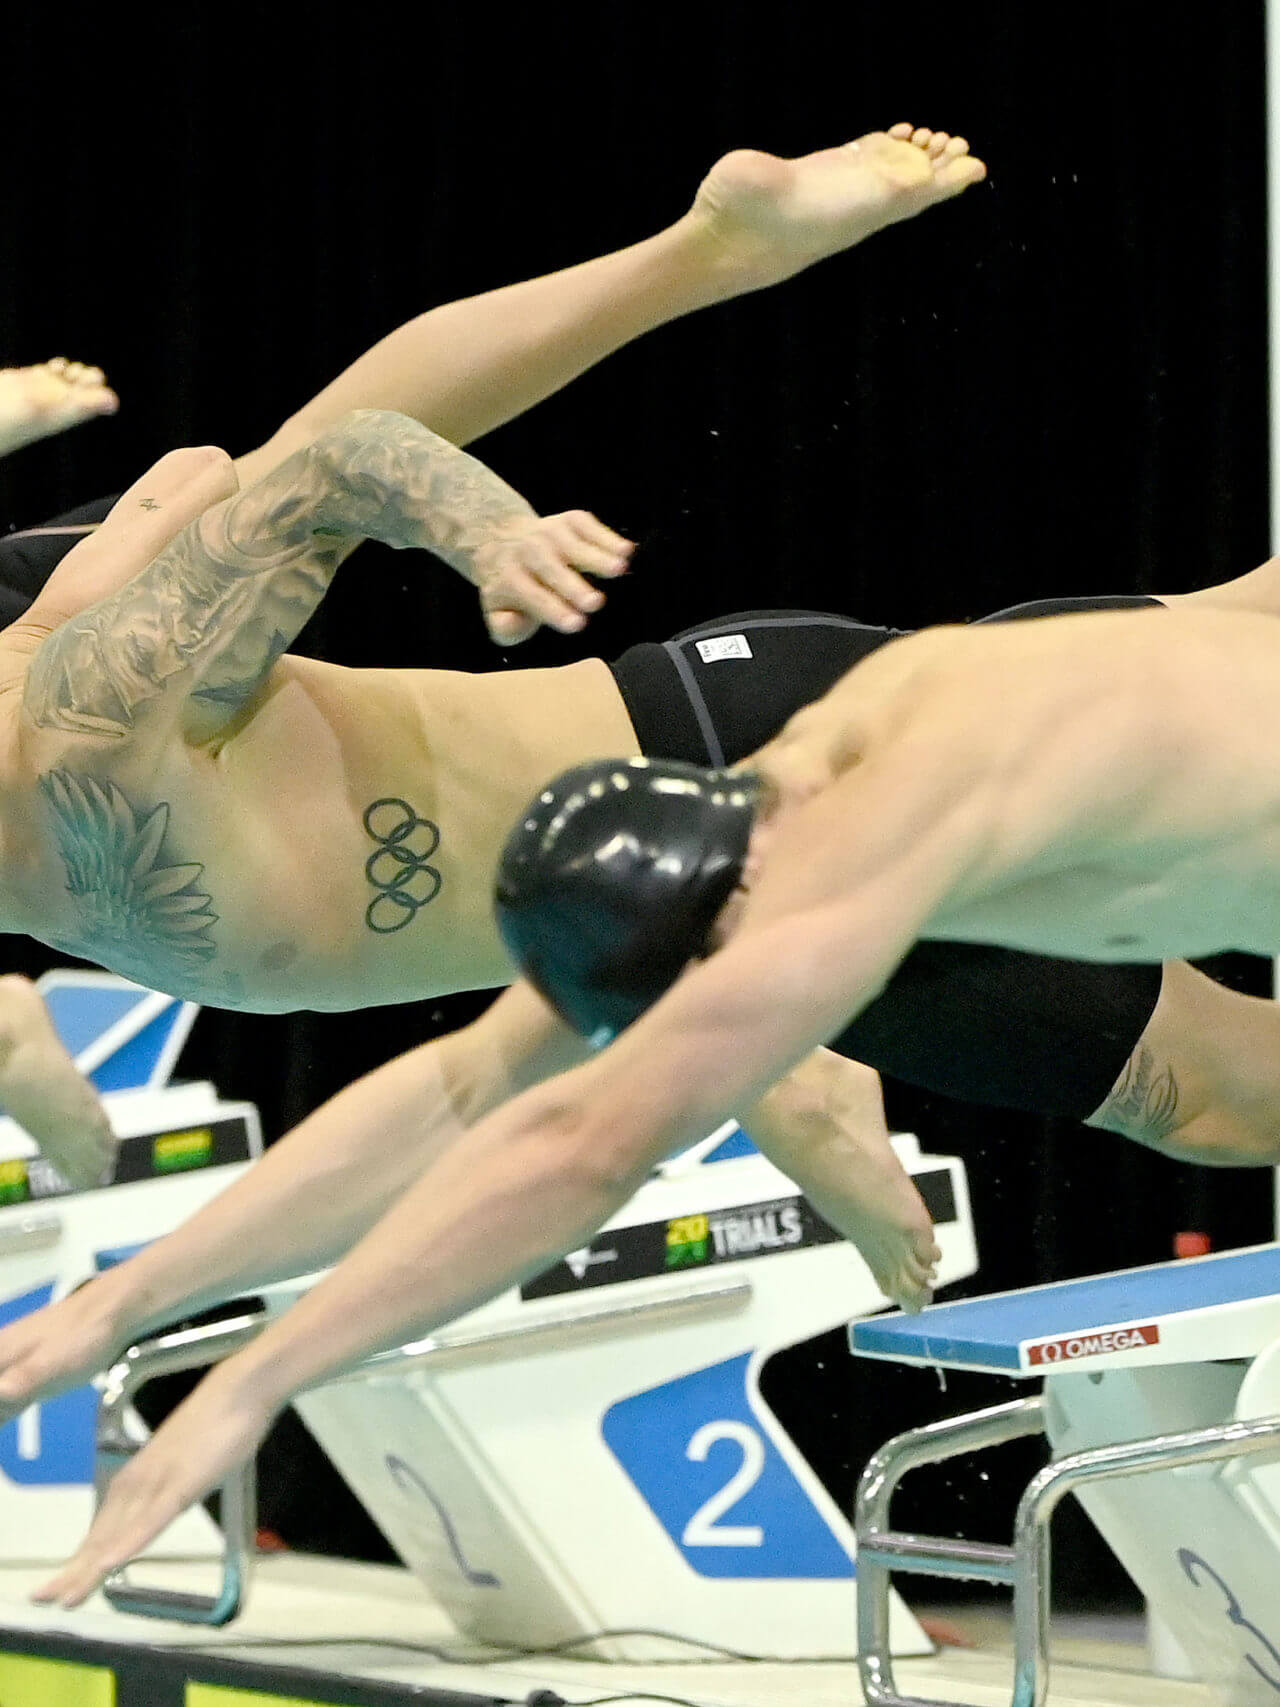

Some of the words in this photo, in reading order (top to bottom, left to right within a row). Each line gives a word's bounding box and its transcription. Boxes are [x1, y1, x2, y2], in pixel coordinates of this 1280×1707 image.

[710, 1206, 804, 1258] TRIALS
[1065, 1329, 1147, 1358] OMEGA
[682, 1419, 766, 1548] 2
